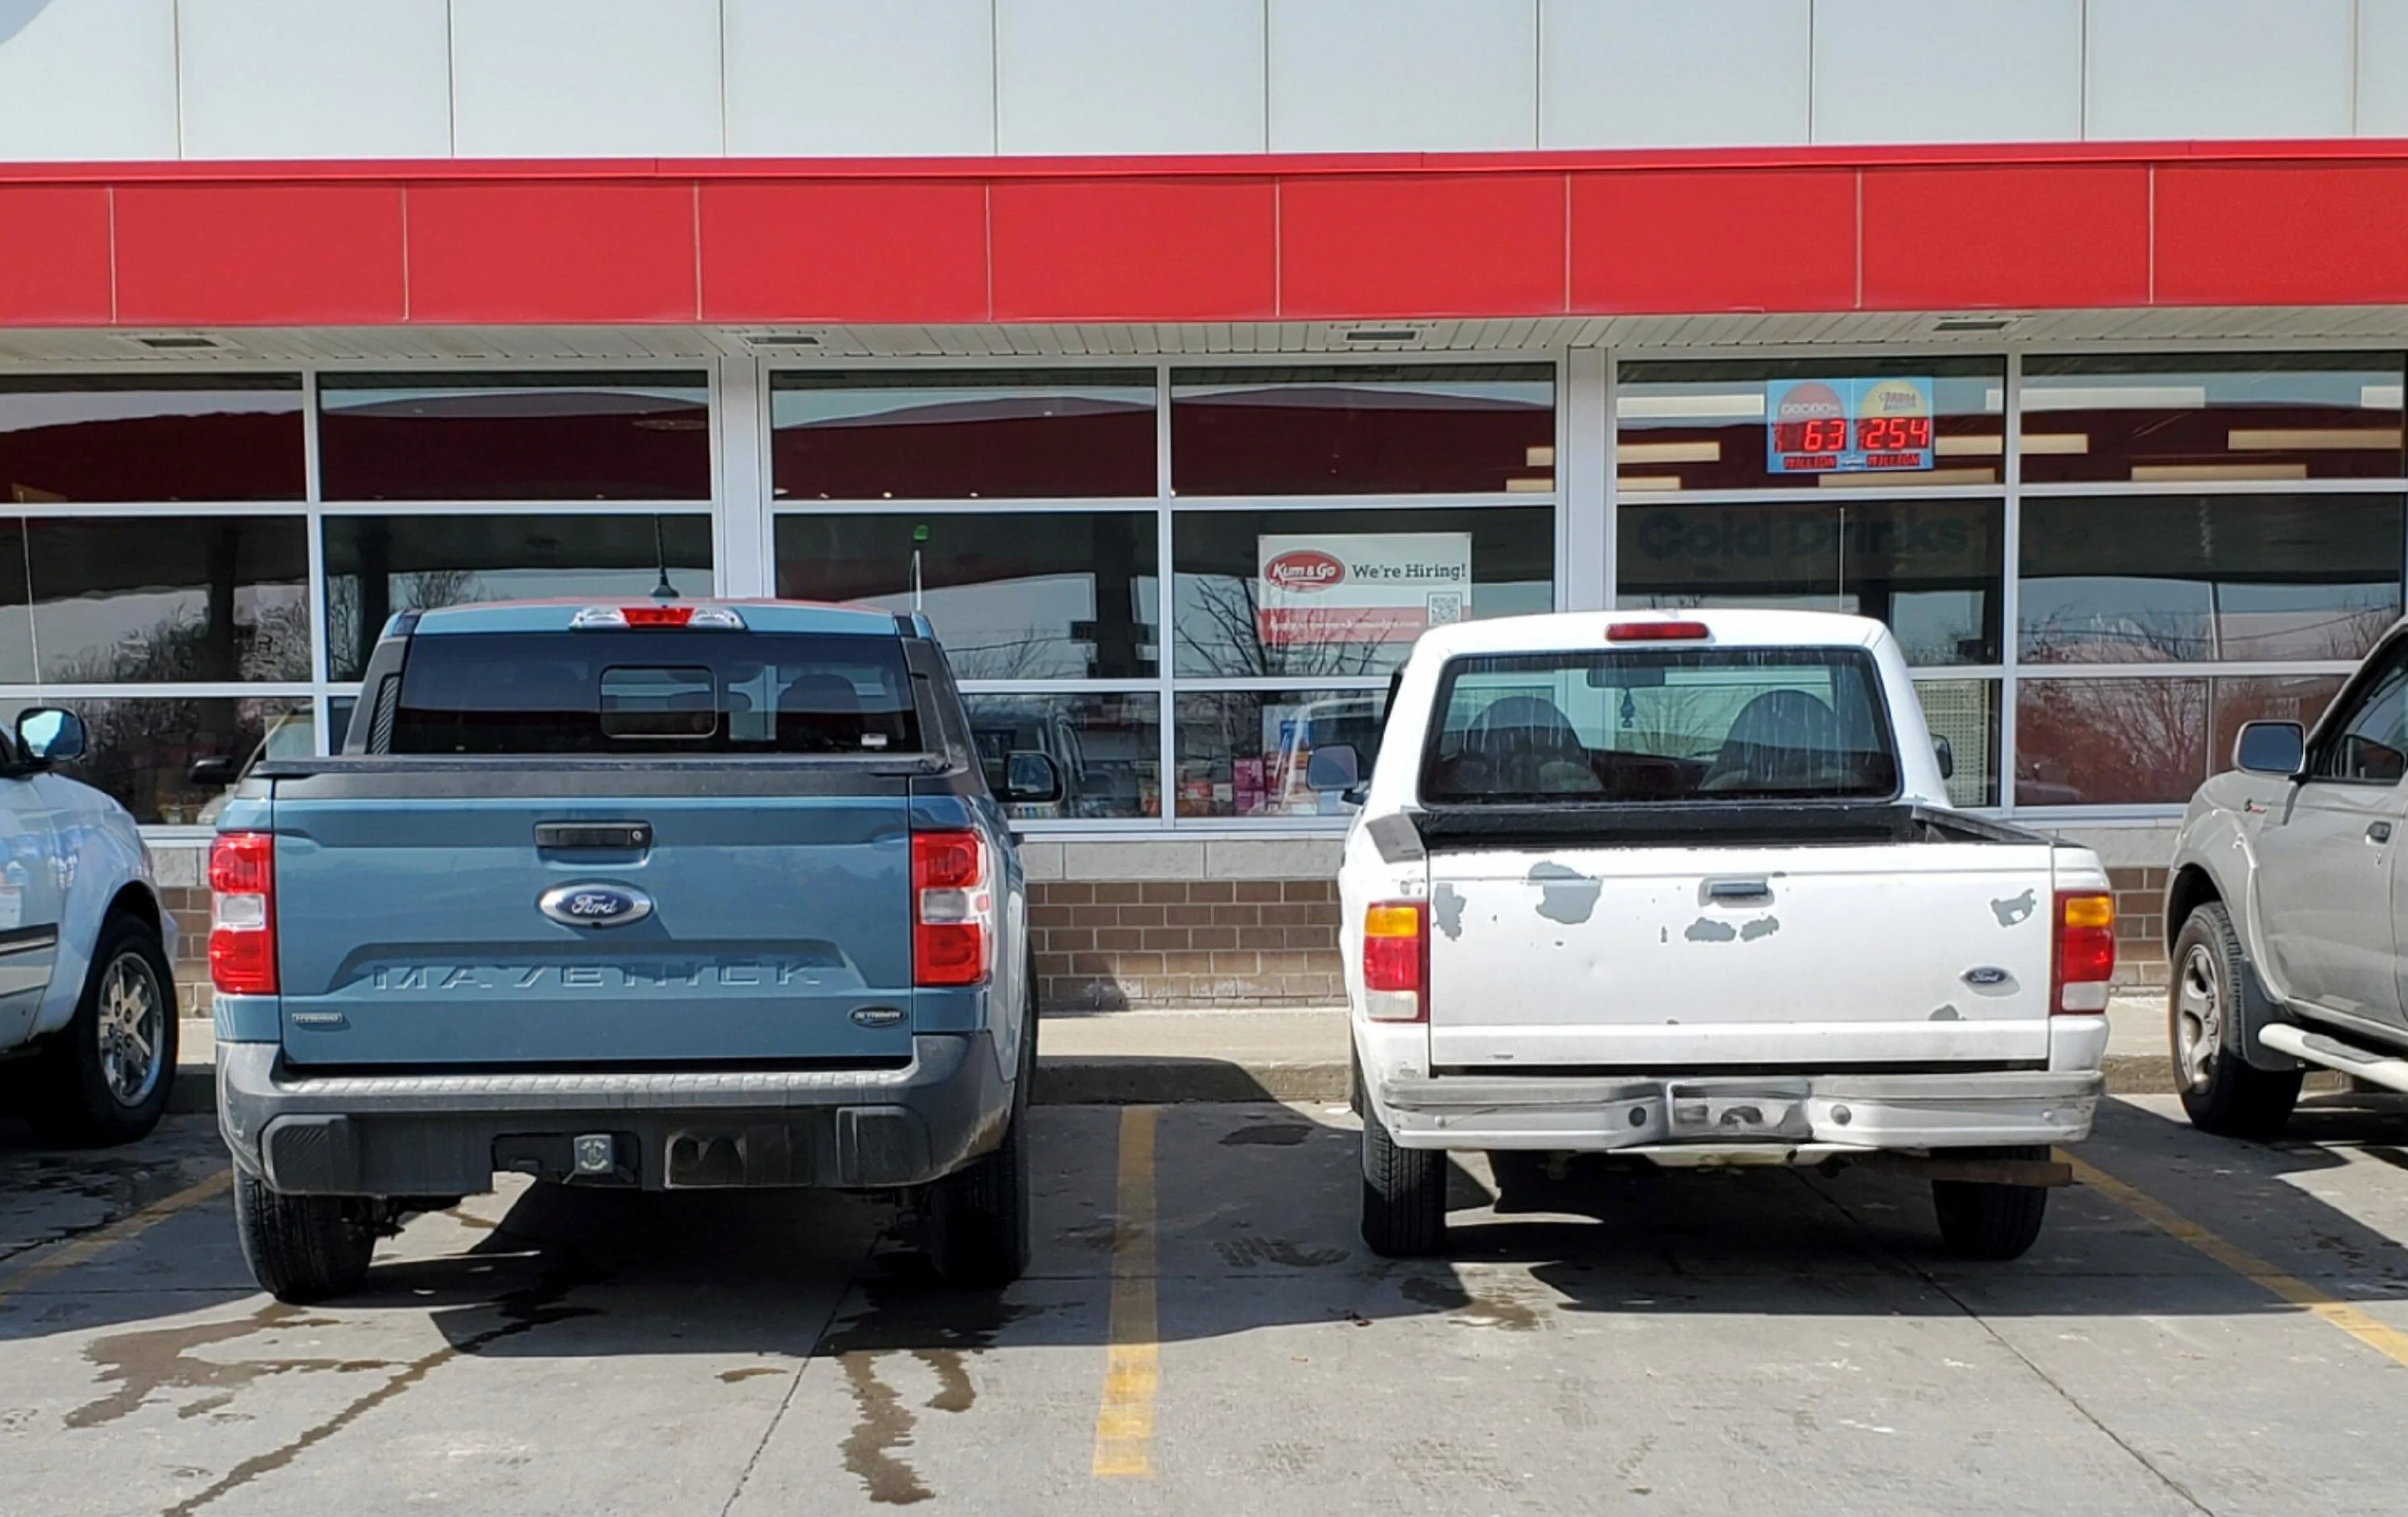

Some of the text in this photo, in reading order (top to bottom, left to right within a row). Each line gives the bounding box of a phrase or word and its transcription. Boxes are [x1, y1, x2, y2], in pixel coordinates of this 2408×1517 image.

[1804, 420, 1845, 451] 63
[1866, 418, 1928, 449] 254
[1637, 509, 1770, 560] Cold
[1272, 563, 1304, 580] Kum
[1317, 563, 1336, 580] Go
[1352, 563, 1466, 580] We're Hiring!
[571, 893, 618, 914] Ford
